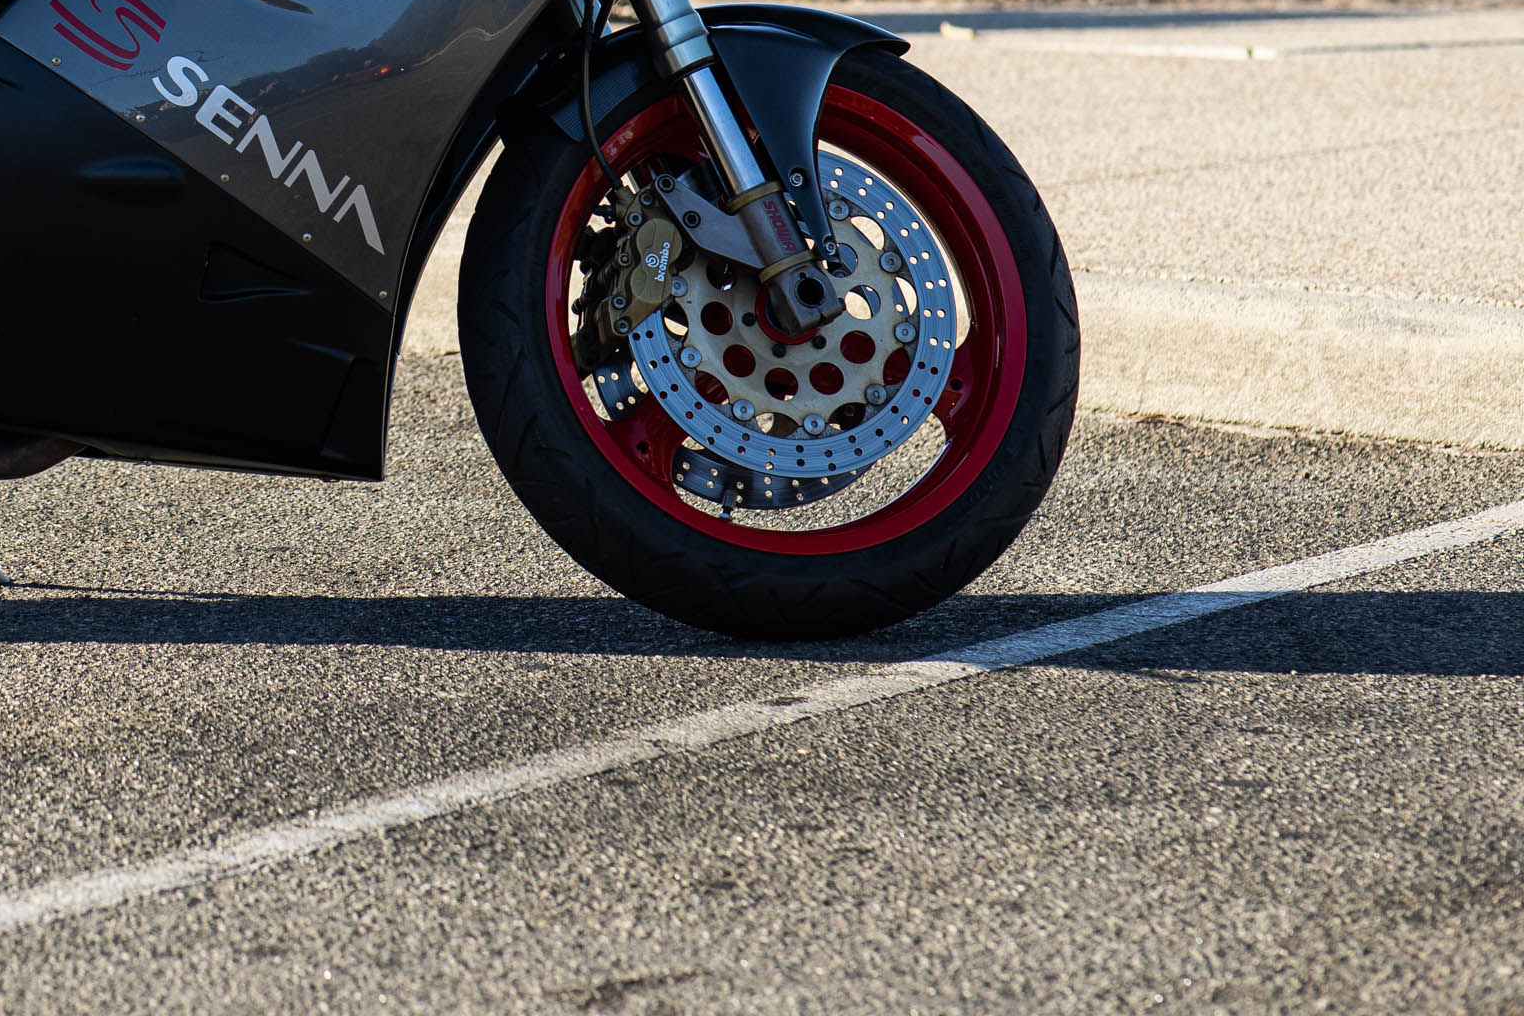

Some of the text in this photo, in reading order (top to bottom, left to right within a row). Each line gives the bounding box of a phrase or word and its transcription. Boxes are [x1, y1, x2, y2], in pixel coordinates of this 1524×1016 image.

[151, 55, 386, 257] SENNA
[763, 199, 797, 253] SHOWA
[654, 241, 671, 282] brembo
